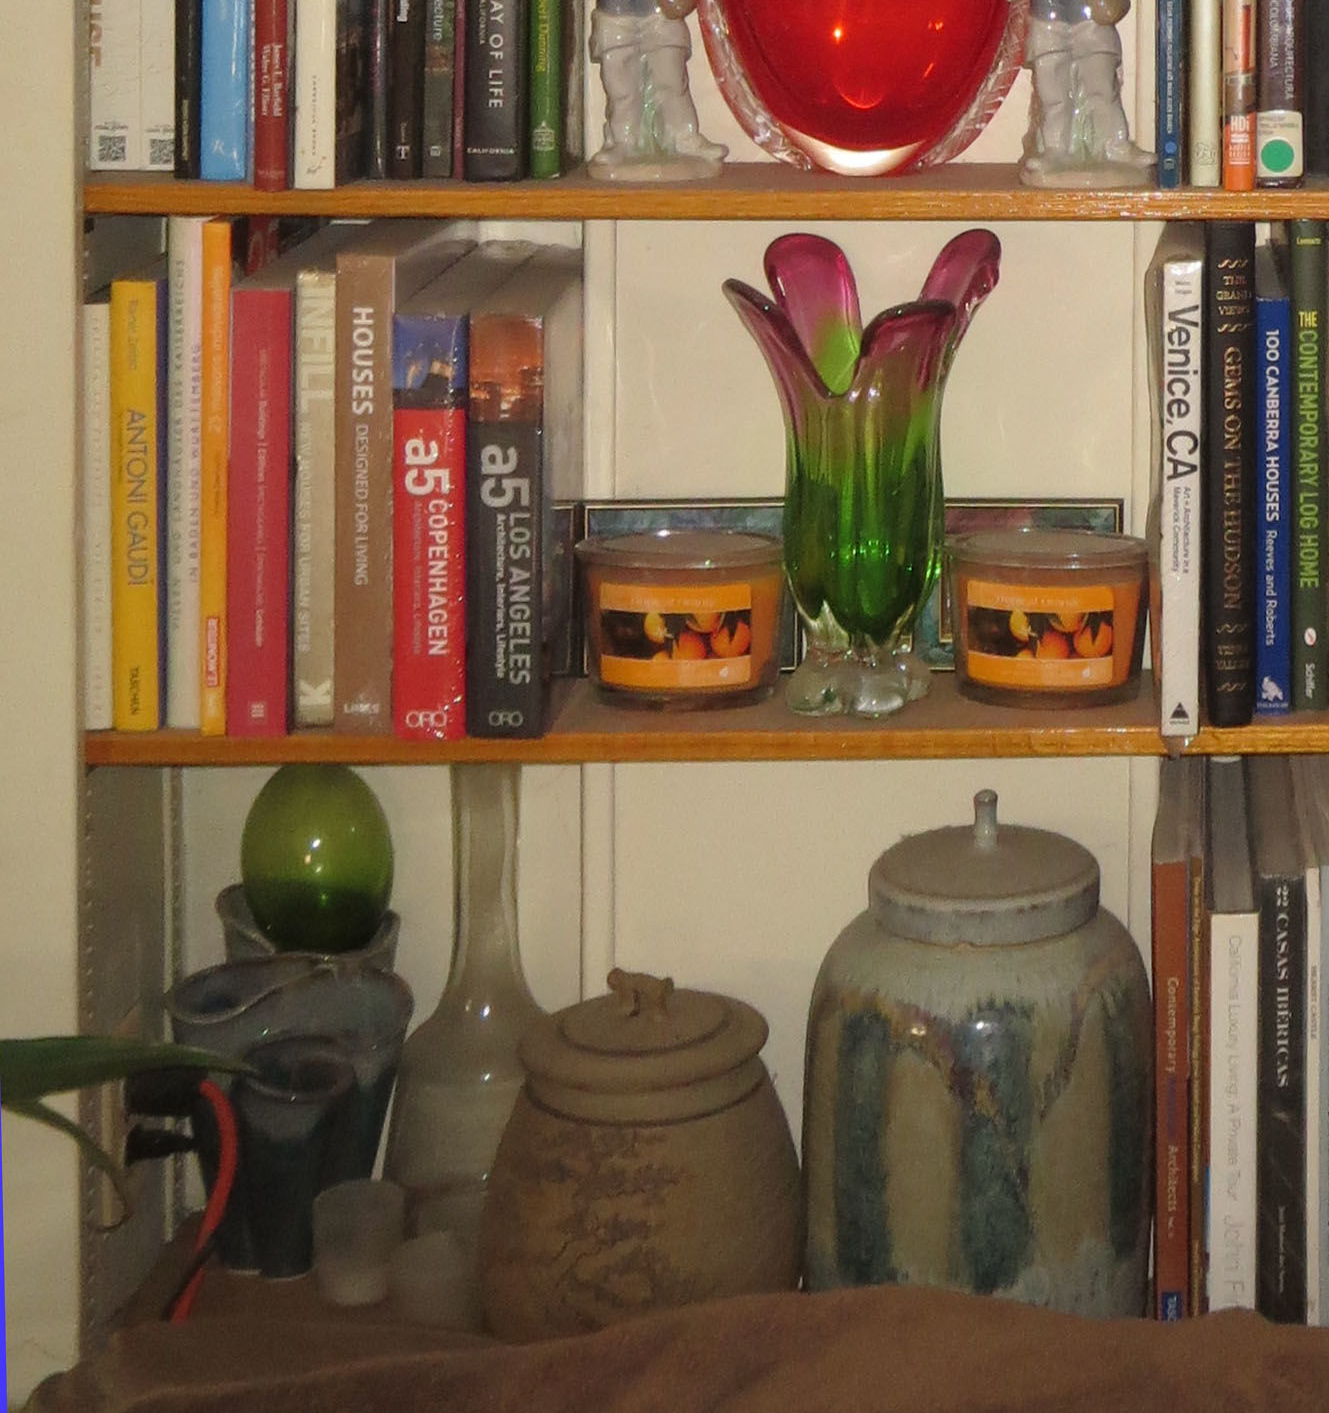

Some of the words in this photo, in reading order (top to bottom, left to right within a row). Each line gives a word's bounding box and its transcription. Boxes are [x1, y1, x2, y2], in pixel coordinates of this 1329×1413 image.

[490, 34, 505, 59] OF
[488, 69, 504, 108] LIFE
[1299, 312, 1318, 327] THE
[352, 307, 373, 415] HOUSES
[1165, 305, 1199, 425] Venice,
[1266, 329, 1280, 361] 100
[1266, 366, 1279, 451] CANBERRA
[1297, 330, 1319, 485] CONTEMPORARY
[355, 424, 369, 500] DESIGNED
[481, 445, 530, 508] a5
[1167, 430, 1198, 481] CA
[1265, 456, 1279, 521] HOUSES
[1299, 491, 1319, 528] LOG
[355, 503, 368, 534] FOR
[509, 512, 530, 560] LOS
[354, 537, 369, 585] LIVING
[405, 439, 450, 494] a5
[428, 500, 447, 655] COPENHAGEN
[1264, 530, 1277, 571] Reeves
[1299, 534, 1320, 587] HOME
[1265, 576, 1277, 596] and
[509, 567, 530, 684] ANGELES
[1265, 600, 1277, 645] Roberts
